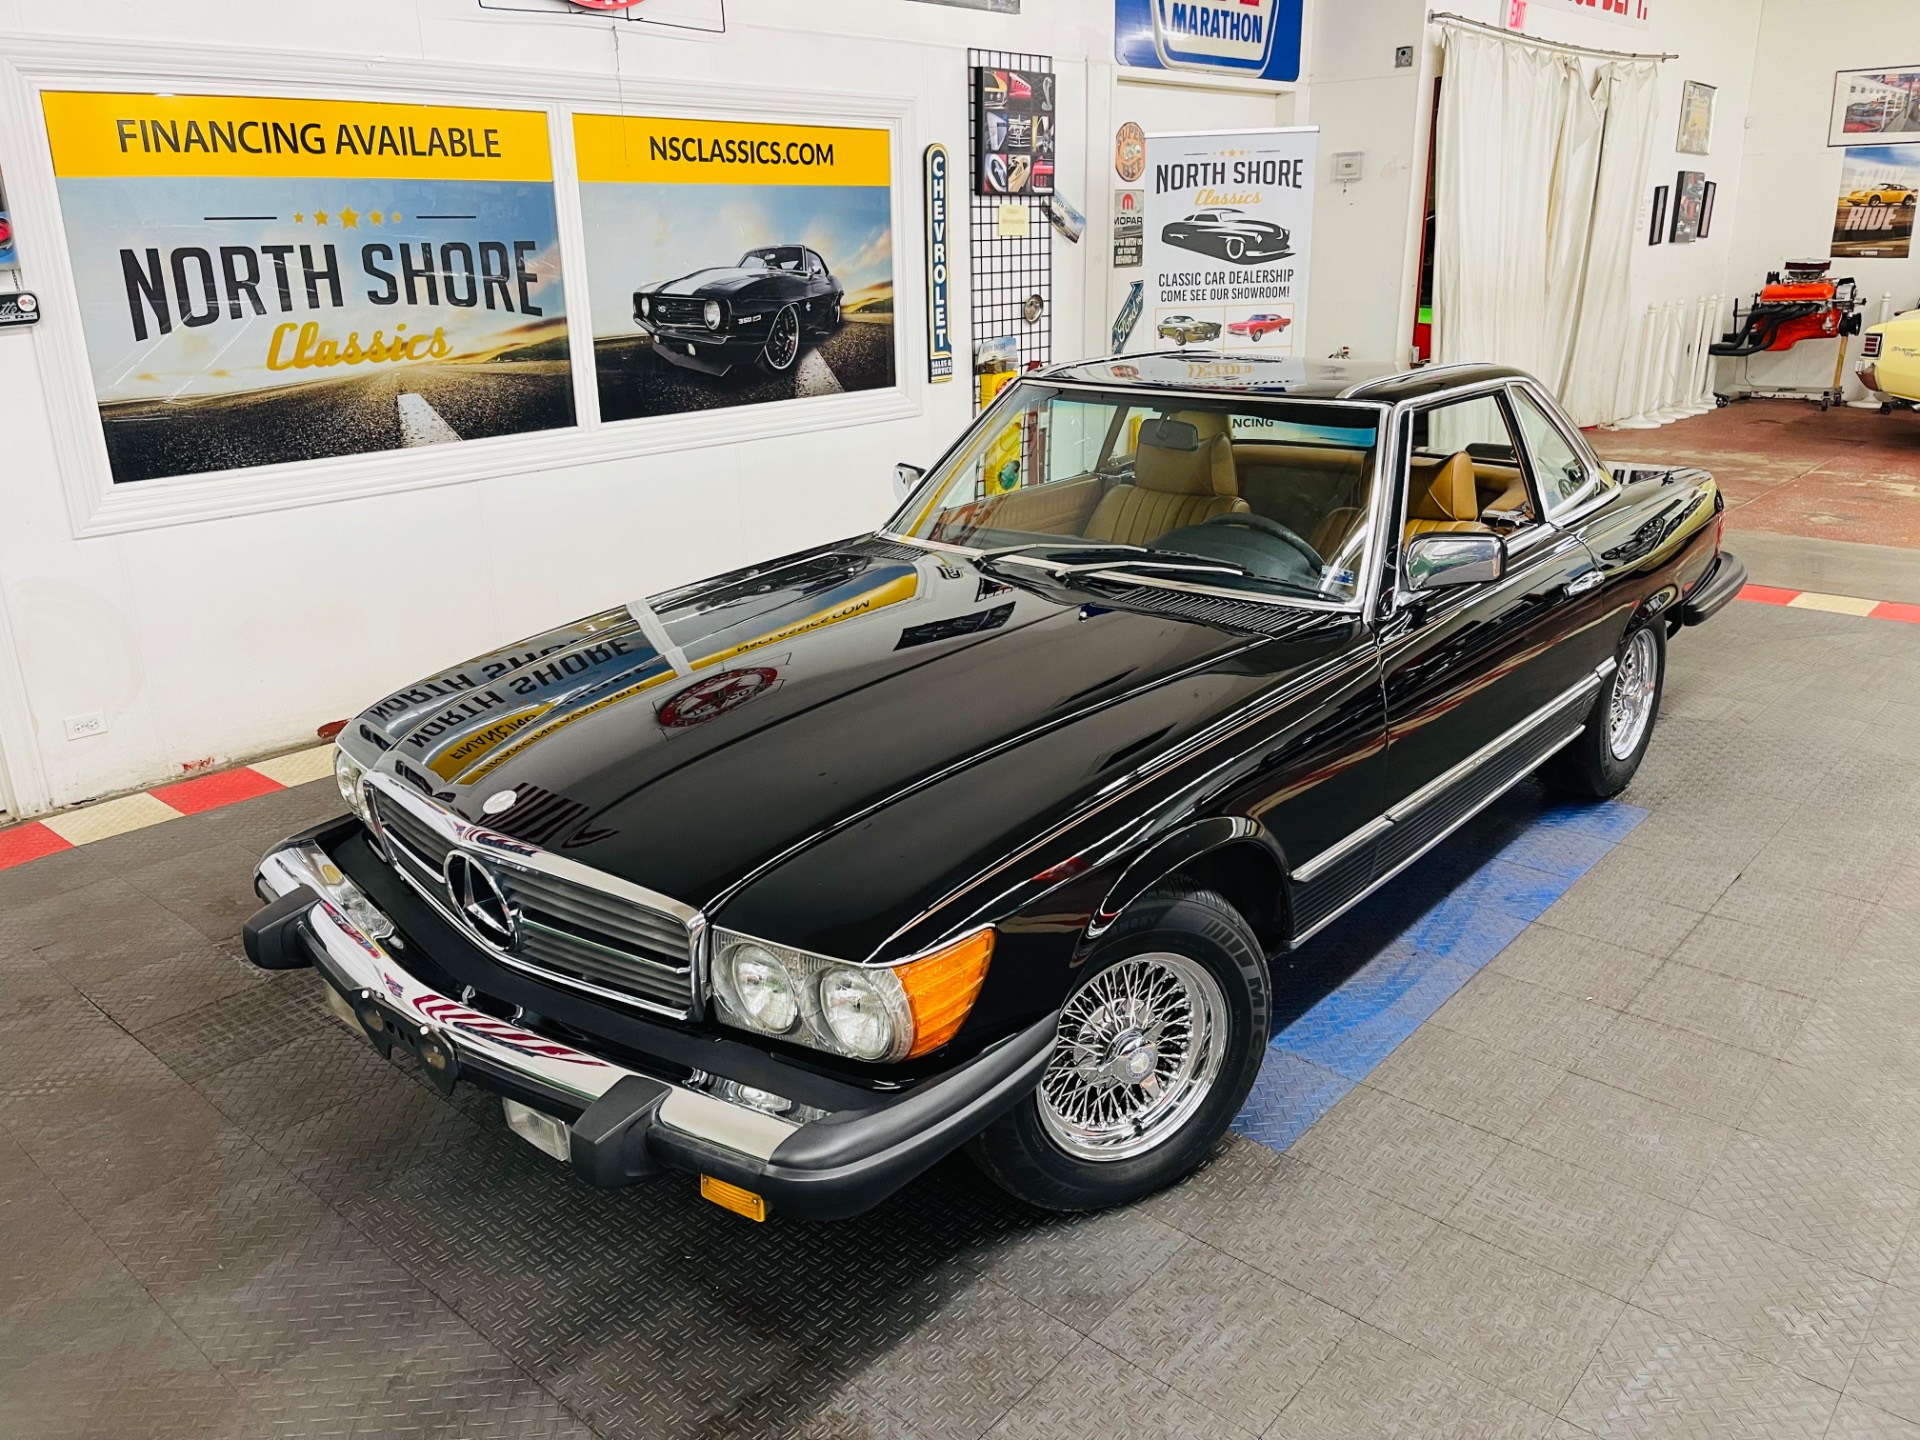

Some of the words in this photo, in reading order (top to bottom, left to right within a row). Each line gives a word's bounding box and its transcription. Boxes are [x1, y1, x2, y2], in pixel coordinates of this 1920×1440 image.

[1171, 2, 1263, 44] MARATHON
[116, 119, 326, 154] FINANCING
[335, 124, 502, 158] AVAILABLE
[649, 135, 834, 166] NSCLASSICS.COM
[1156, 162, 1226, 195] NORTH
[1233, 159, 1304, 189] SHORE
[1194, 189, 1263, 206] Classics
[1844, 206, 1898, 231] RIDE
[932, 156, 947, 348] CHEVROLET
[119, 243, 342, 342] NORTH
[361, 240, 544, 317] SHORE
[1158, 272, 1201, 287] CLASSIC
[1205, 271, 1226, 286] CAR
[1229, 268, 1294, 284] DEALERSHIP
[1160, 290, 1188, 303] COME
[1190, 288, 1208, 301] SEE
[1210, 288, 1229, 301] OUR
[1231, 286, 1290, 299] SHOWROOM!
[266, 321, 455, 371] Classics
[1232, 418, 1274, 429] NCING
